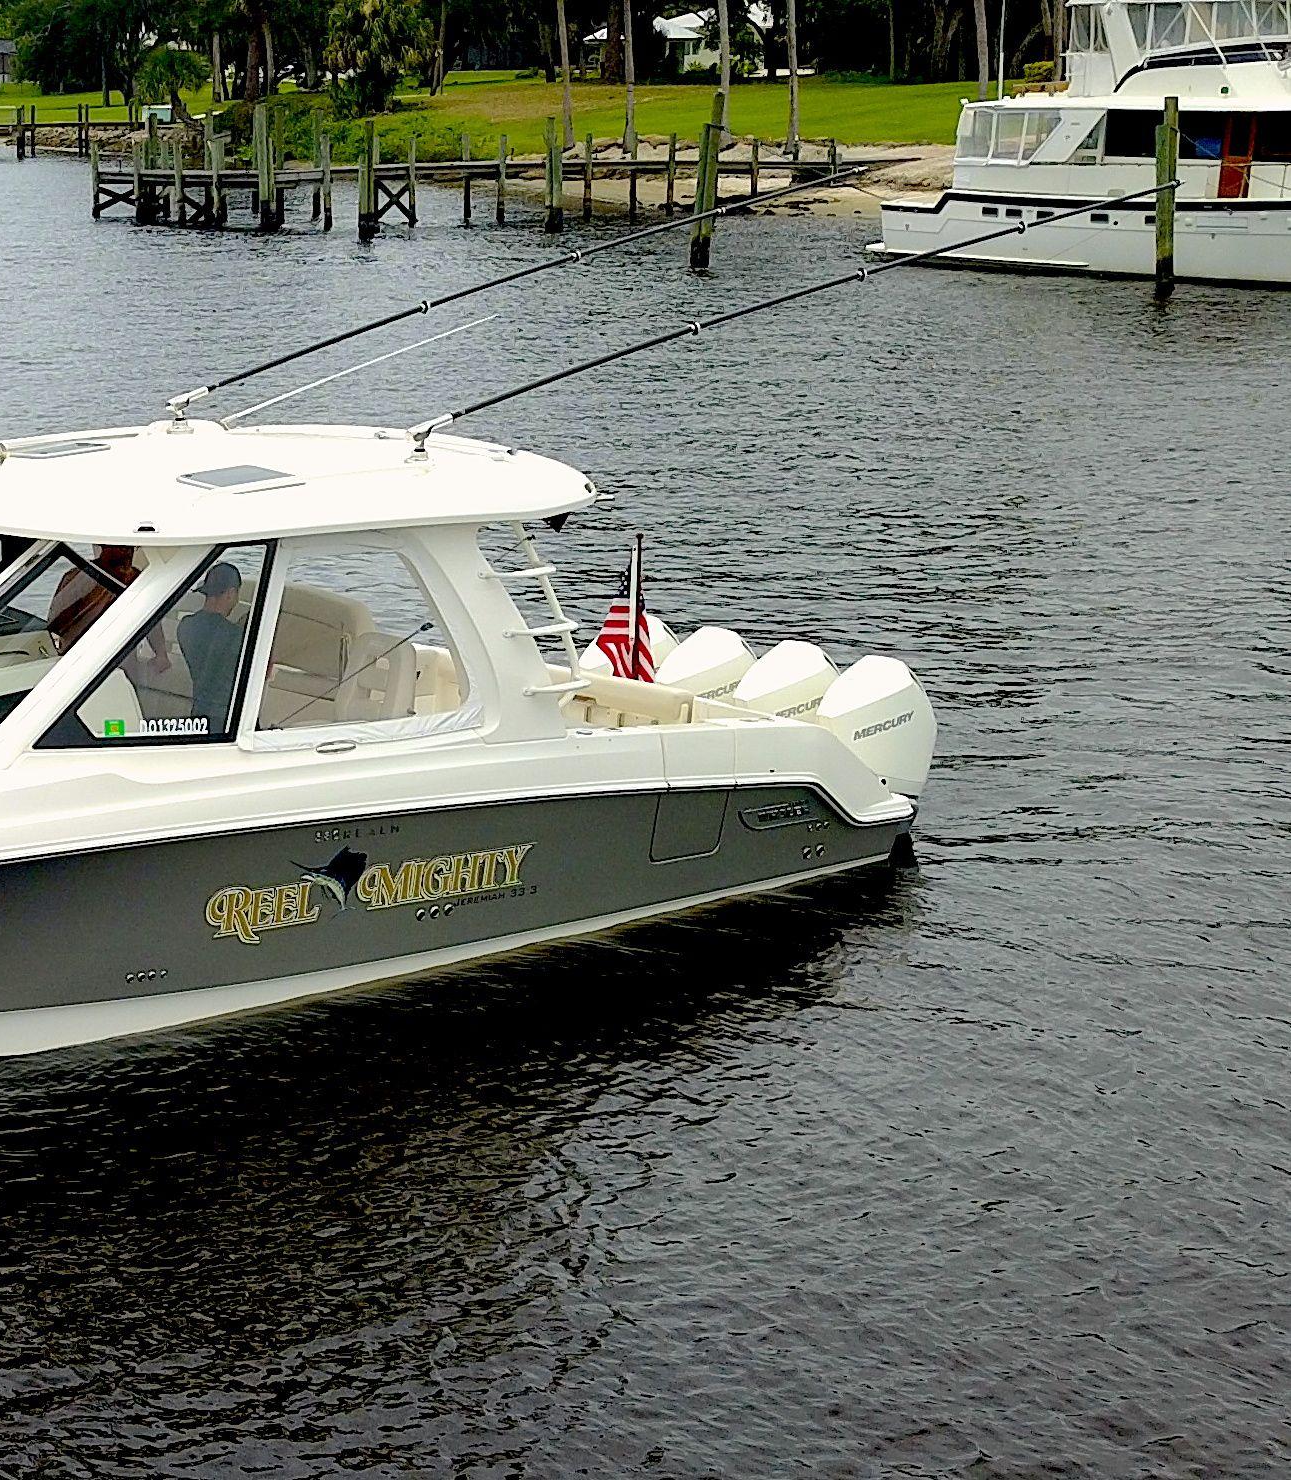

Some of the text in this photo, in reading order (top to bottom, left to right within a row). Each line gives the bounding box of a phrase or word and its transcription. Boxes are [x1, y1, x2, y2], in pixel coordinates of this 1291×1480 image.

[695, 680, 741, 699] ERCUR
[776, 696, 823, 718] ERCUR
[854, 710, 914, 741] MERCURY
[206, 842, 537, 944] REEL MIGHTY
